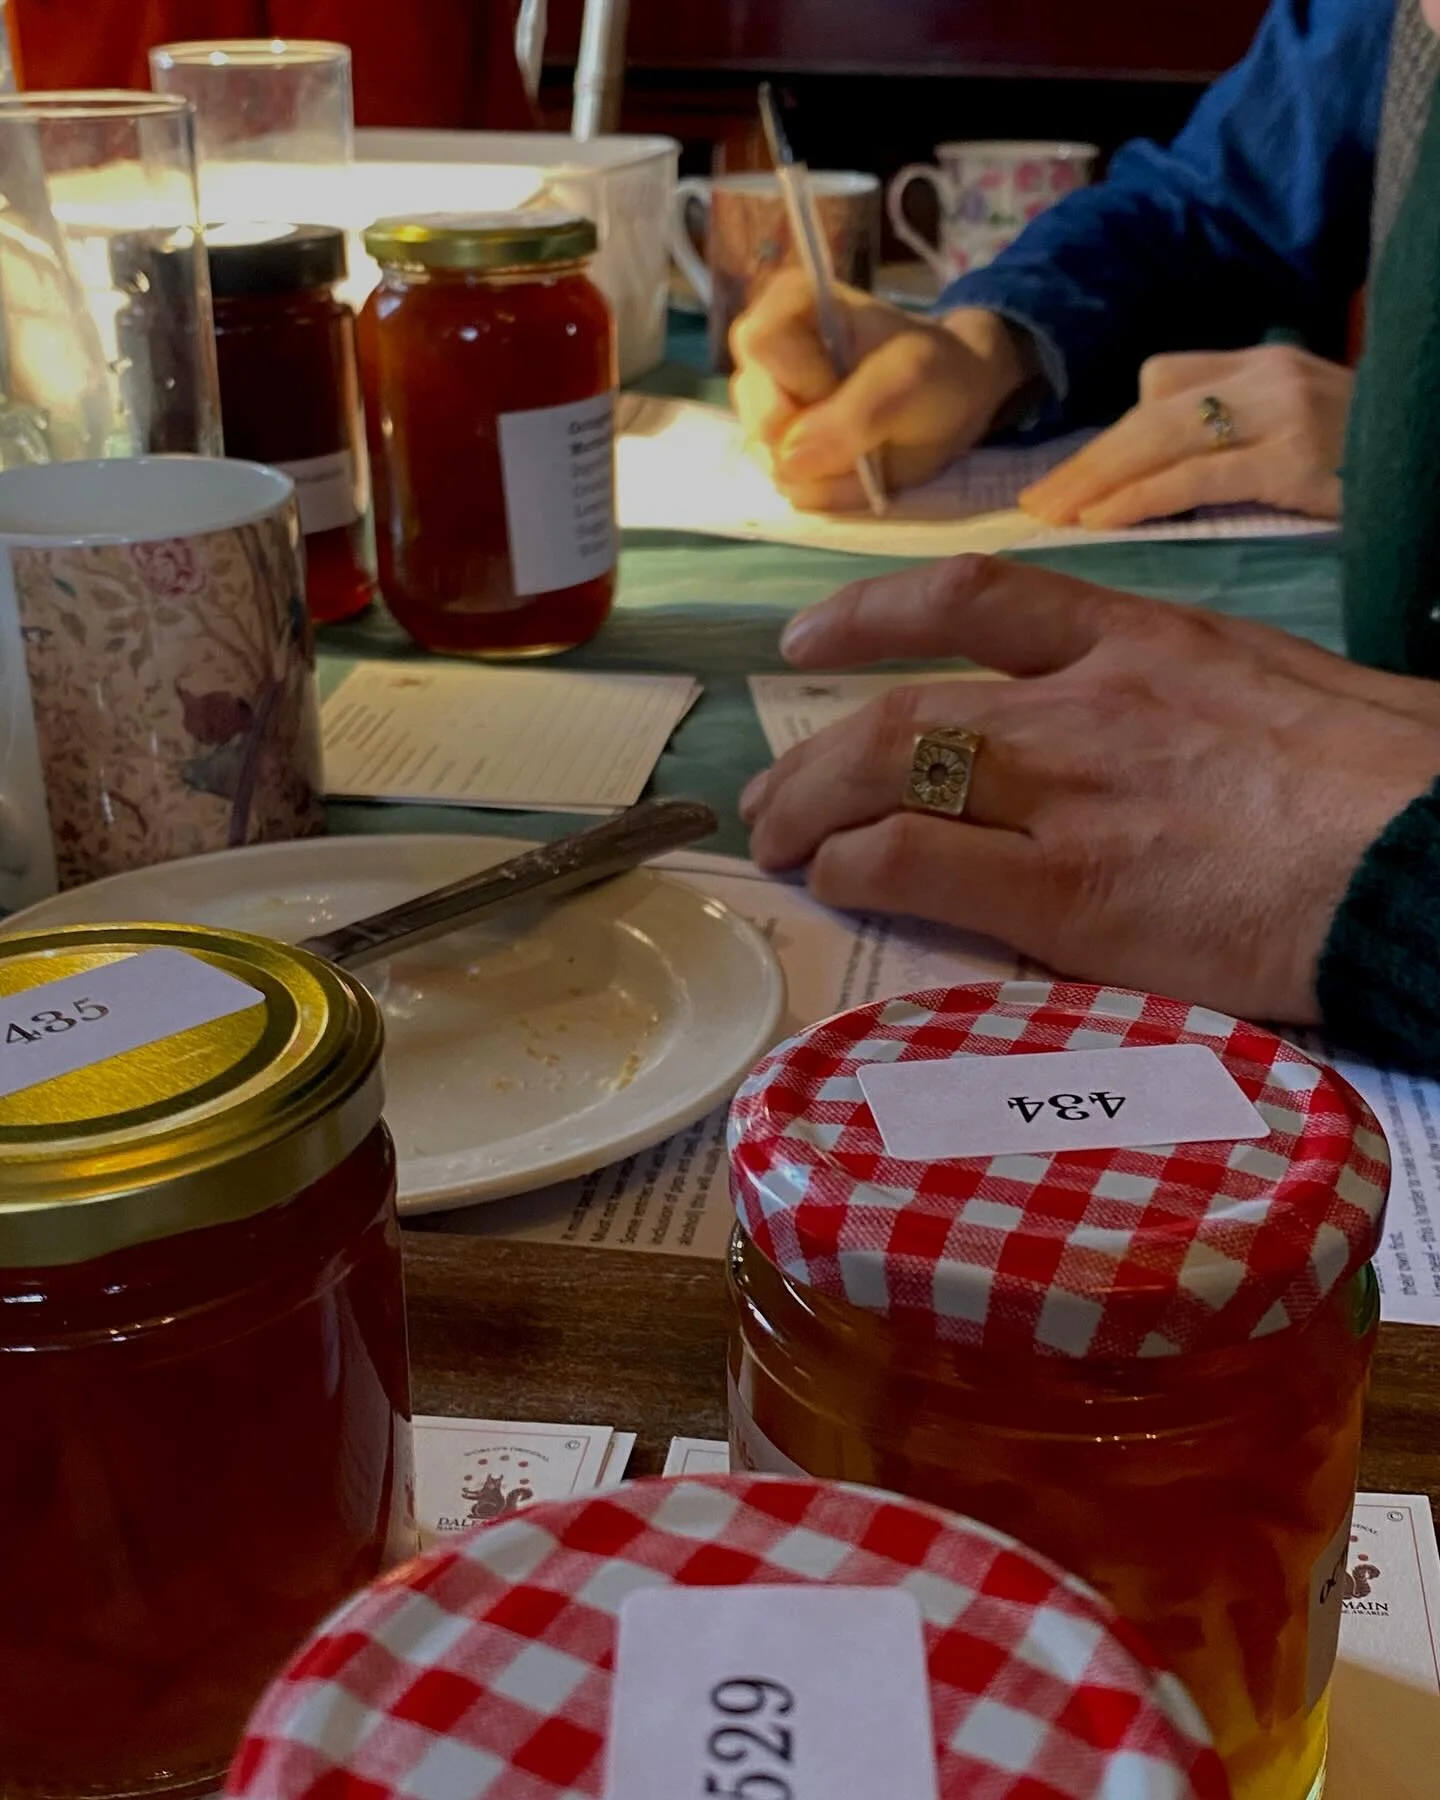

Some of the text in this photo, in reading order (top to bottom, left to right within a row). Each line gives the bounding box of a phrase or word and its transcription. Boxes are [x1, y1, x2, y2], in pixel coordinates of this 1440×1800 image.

[4, 996, 110, 1045] 435
[1007, 1091, 1127, 1124] 434
[704, 1676, 794, 1800] 529
